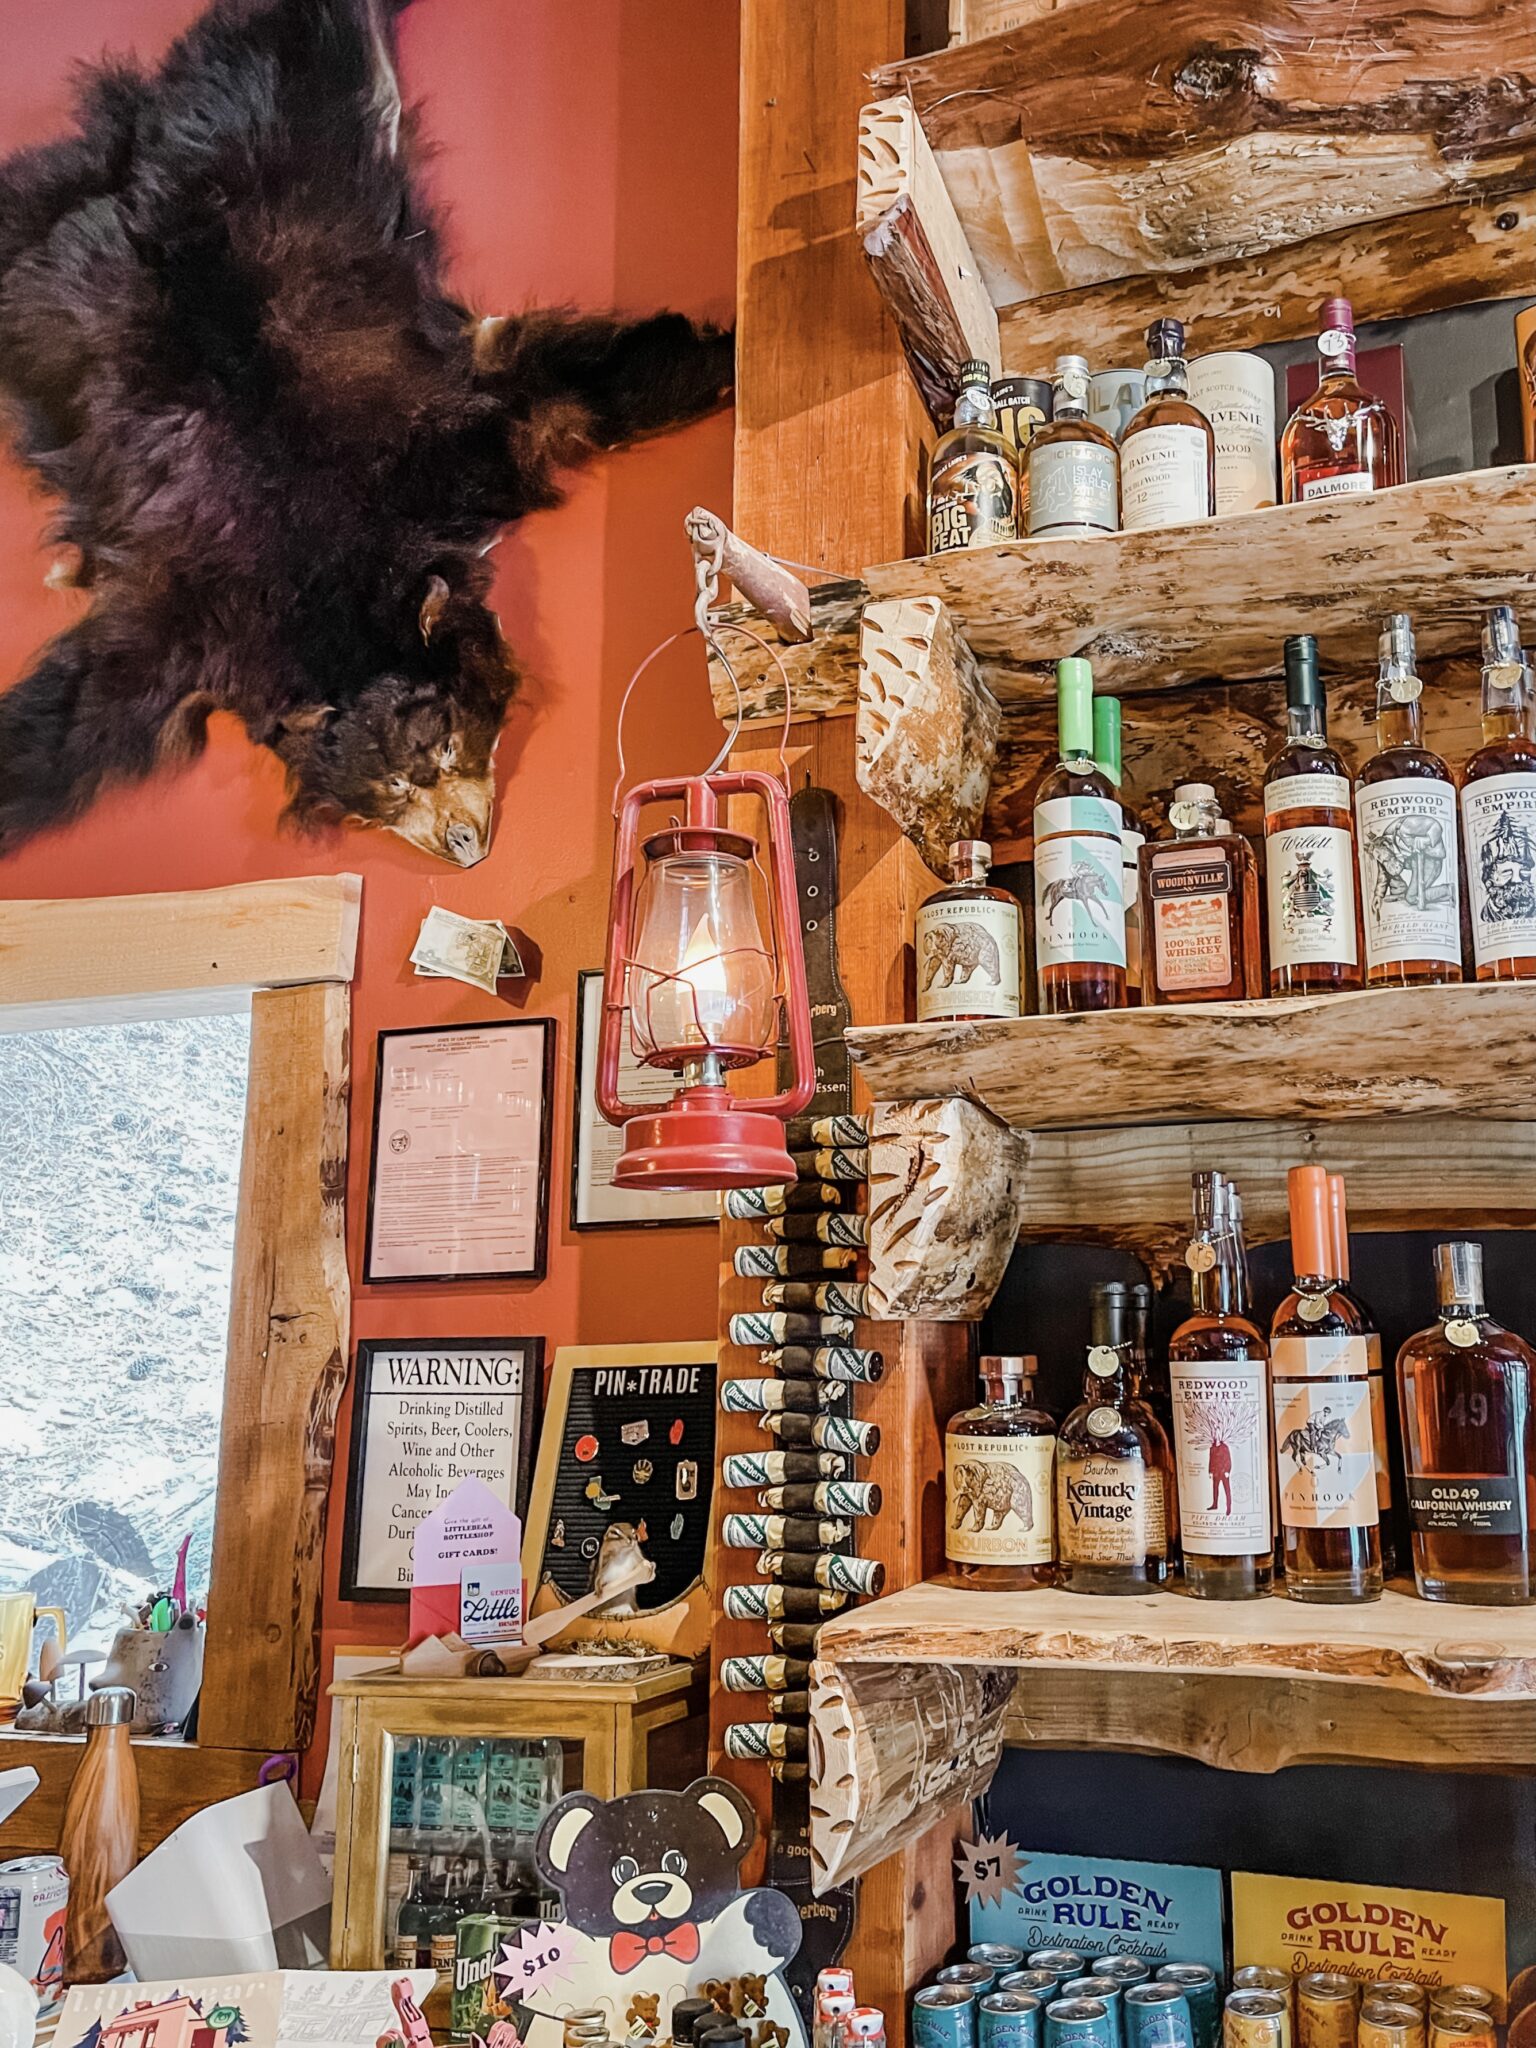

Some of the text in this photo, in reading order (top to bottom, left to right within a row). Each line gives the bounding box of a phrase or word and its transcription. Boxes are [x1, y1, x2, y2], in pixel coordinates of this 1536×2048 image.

[1073, 465, 1103, 480] ISLAY
[1073, 476, 1112, 492] BARLEY
[1308, 480, 1368, 499] DALMORE
[1136, 491, 1148, 504] 12
[931, 504, 969, 537] BIG
[931, 526, 972, 554] PEAT
[1370, 796, 1444, 810] REDWOOD
[1173, 807, 1193, 825] 47
[1279, 833, 1333, 853] Willett
[1156, 872, 1224, 889] WOODINVILLE
[926, 906, 993, 919] LOST REPUBLIC
[1164, 935, 1223, 950] 100% RYE
[1165, 945, 1223, 958] WHISKEY
[816, 1082, 847, 1094] Essen
[388, 1357, 521, 1386] WARNING:
[1178, 1380, 1249, 1390] REDWOOD
[399, 1400, 504, 1418] Drinking Distilled
[1448, 1392, 1488, 1427] 49
[387, 1421, 513, 1439] Spirits, Beer, Coolers,
[403, 1441, 495, 1458] Wine and Other
[957, 1443, 1024, 1452] LOST REPUBLIC
[388, 1462, 444, 1478] Alcoholic
[1083, 1459, 1119, 1476] Bourbon
[406, 1483, 432, 1501] May
[1066, 1476, 1137, 1506] Kentucky
[1284, 1491, 1357, 1502] PINHOOK
[1431, 1487, 1480, 1500] OLD 49
[1067, 1501, 1133, 1526] Vintage
[1411, 1500, 1512, 1512] CALIFORNIA WHISKEY
[443, 1530, 495, 1542] BOTTLESHOP
[444, 1523, 494, 1533] LITTLEBEAR
[438, 1550, 461, 1559] GIFT
[490, 1587, 521, 1597] GENUINE
[463, 1597, 520, 1623] Little
[974, 1856, 1001, 1881] $7
[1023, 1874, 1174, 1918] GOLDEN
[1018, 1907, 1048, 1918] DRINK
[1052, 1903, 1143, 1933] RULE
[1147, 1919, 1180, 1931] READY
[1286, 1901, 1449, 1945] GOLDEN
[1027, 1925, 1168, 1959] Destination Cocktails
[1280, 1932, 1314, 1943] DRINK
[1318, 1929, 1416, 1960] RULE
[1421, 1946, 1457, 1959] READY
[522, 1946, 561, 1977] $10
[1291, 1951, 1377, 1981] Destination
